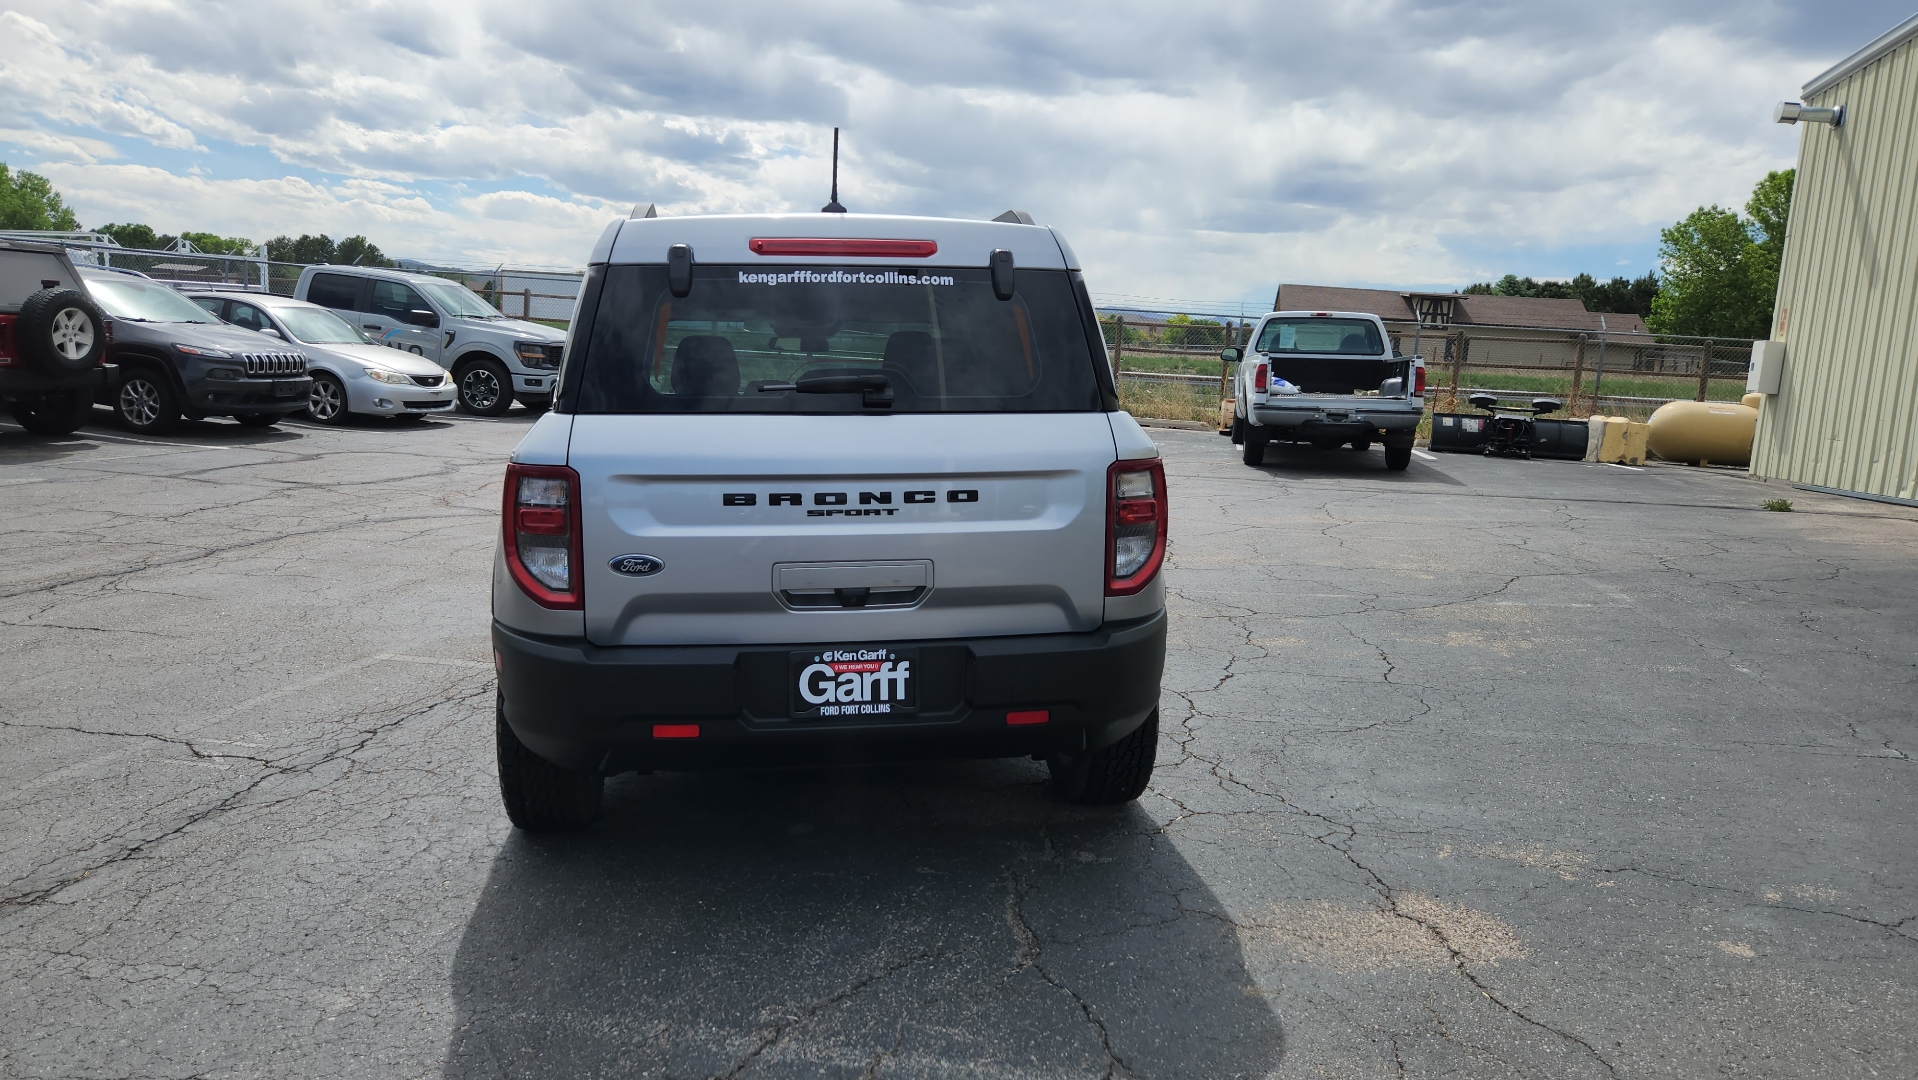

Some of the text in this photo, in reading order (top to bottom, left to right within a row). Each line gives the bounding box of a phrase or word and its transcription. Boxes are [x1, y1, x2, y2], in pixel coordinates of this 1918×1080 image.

[738, 270, 954, 286] kengarfffordfortcollins.com
[722, 489, 979, 506] BRONCO
[806, 508, 900, 517] SPORT
[620, 558, 651, 572] Ford
[834, 648, 887, 662] Ken Garff
[799, 661, 910, 704] Garff
[820, 703, 891, 716] FORD FORT COLLINS
